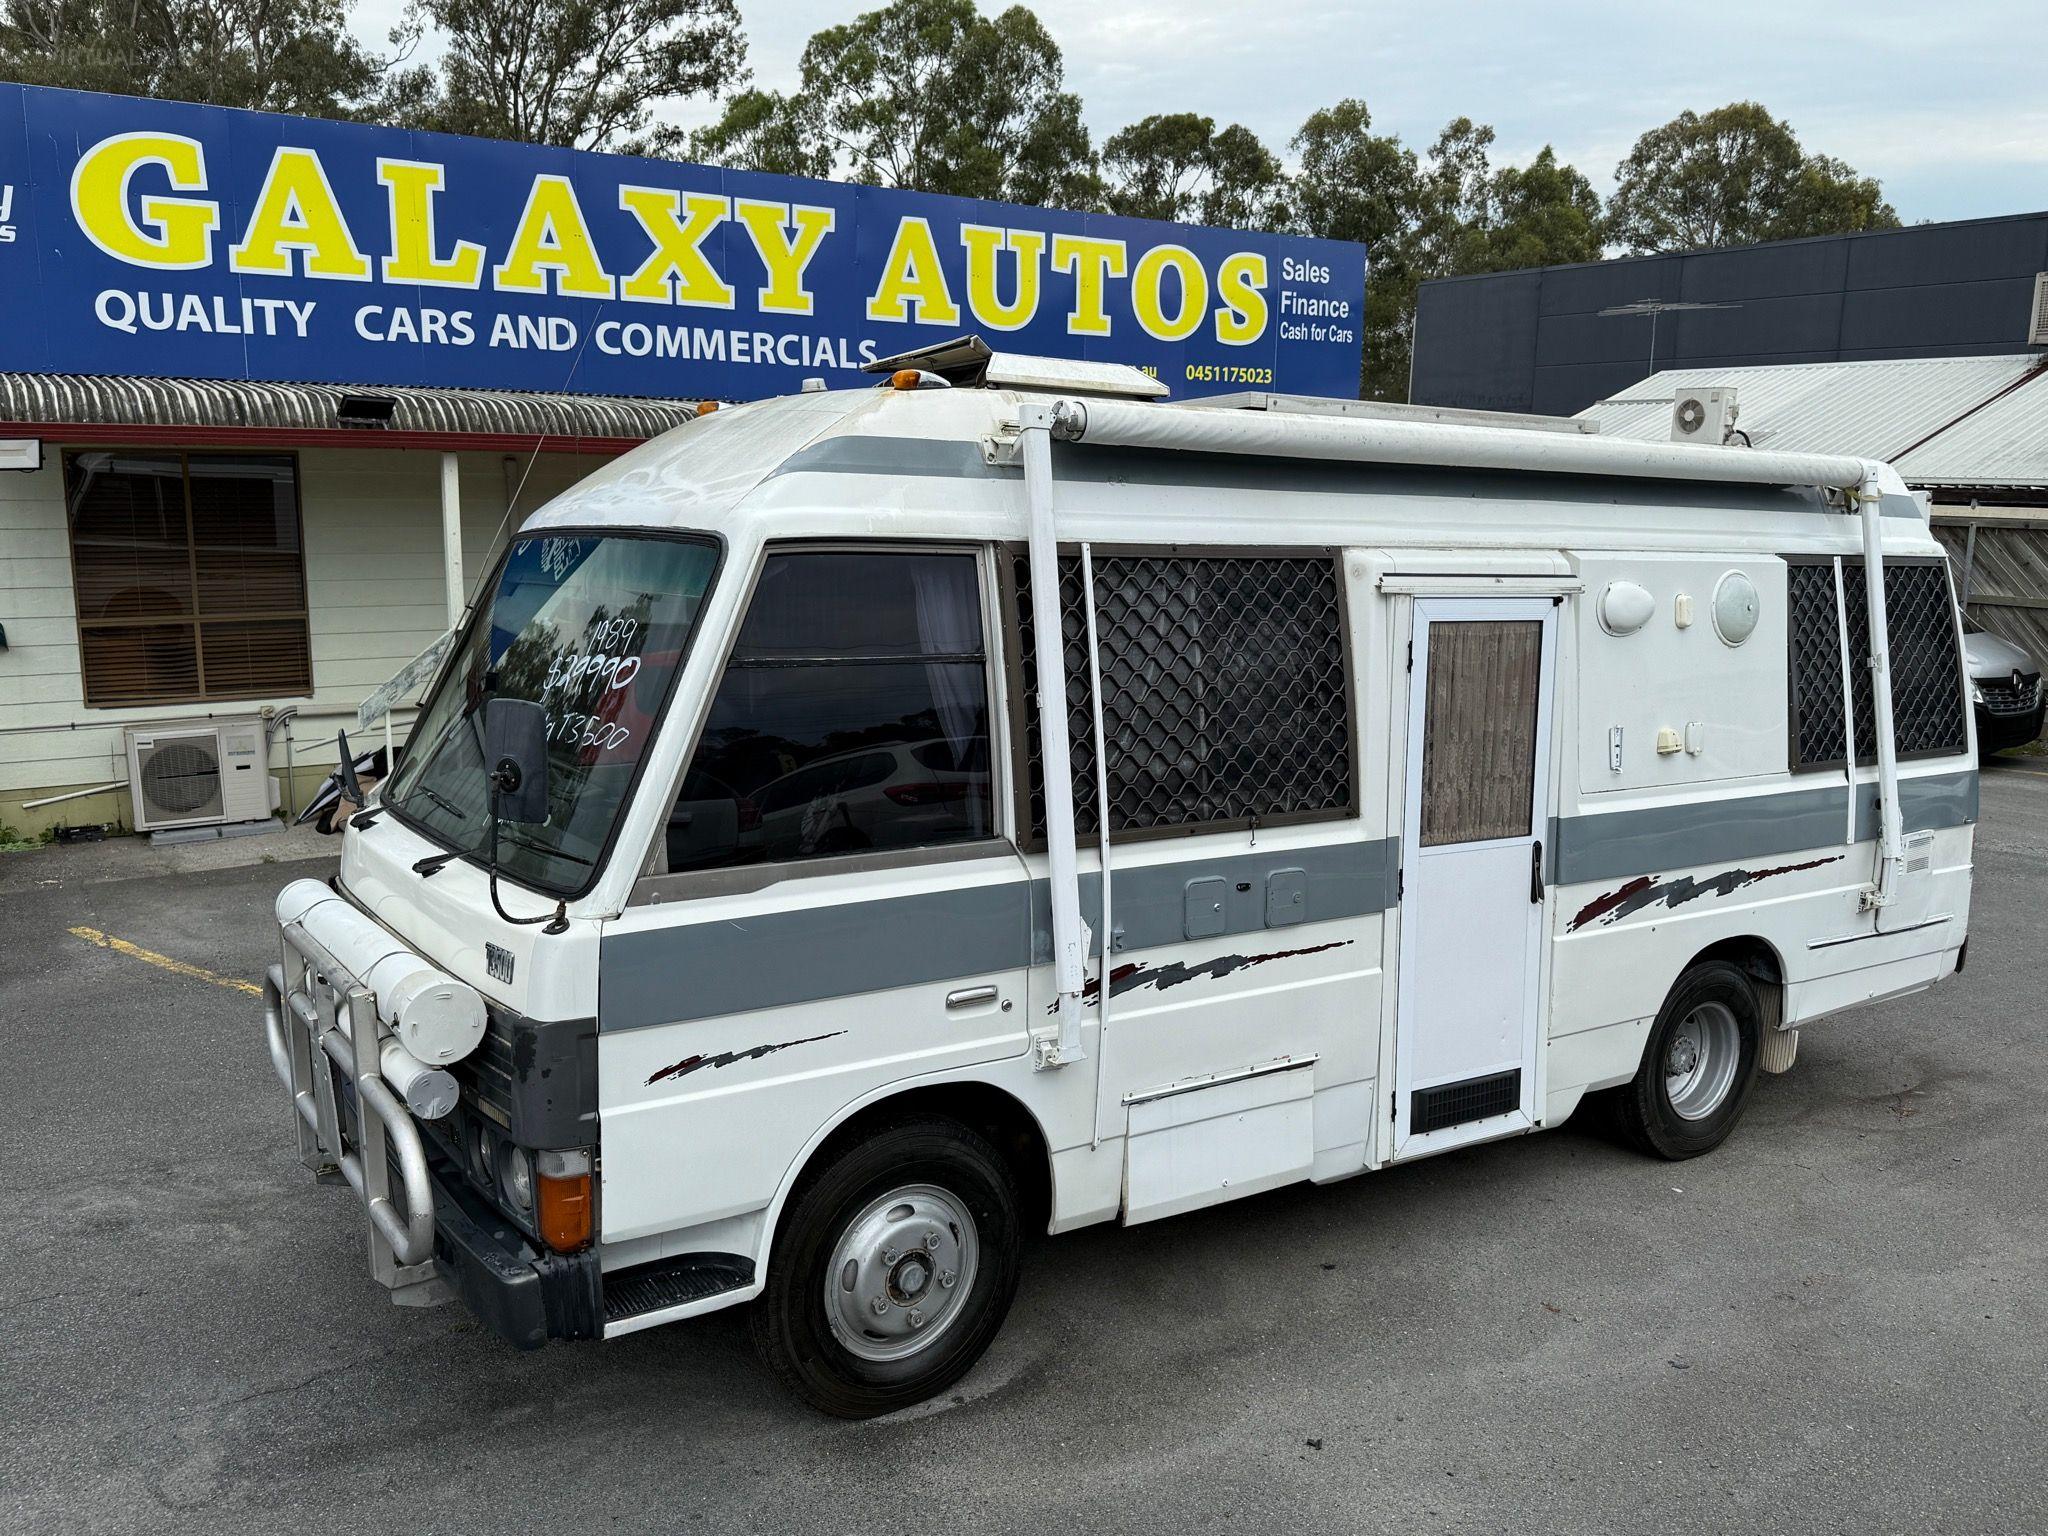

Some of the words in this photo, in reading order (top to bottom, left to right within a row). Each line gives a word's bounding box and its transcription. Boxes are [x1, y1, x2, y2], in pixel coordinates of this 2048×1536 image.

[69, 130, 836, 317] GALAXY
[866, 216, 1269, 346] AUTOS
[1282, 256, 1330, 284] Sales
[1281, 290, 1349, 318] Finance
[94, 288, 317, 337] QUALITY
[354, 304, 476, 346] CARS
[489, 312, 578, 352] AND
[595, 320, 878, 370] COMMERCIALS
[1280, 321, 1308, 340] Cash
[1311, 323, 1327, 341] for
[1328, 324, 1353, 343] Cars
[1186, 364, 1273, 384] 0451175023
[586, 618, 638, 656] 1989
